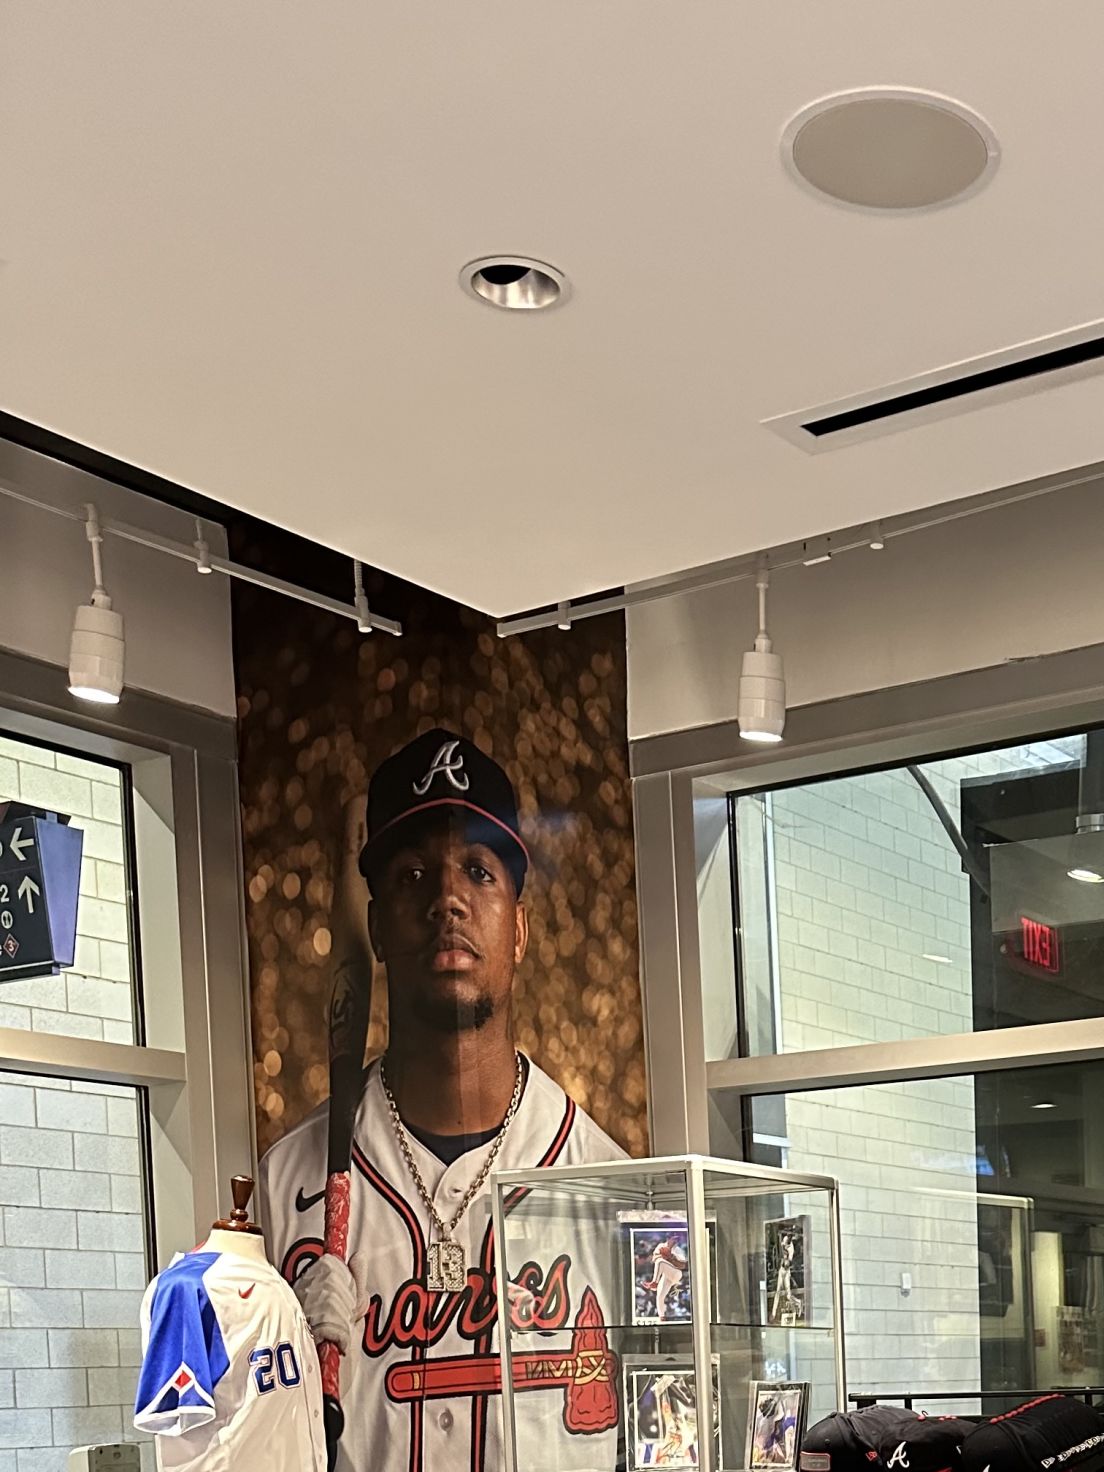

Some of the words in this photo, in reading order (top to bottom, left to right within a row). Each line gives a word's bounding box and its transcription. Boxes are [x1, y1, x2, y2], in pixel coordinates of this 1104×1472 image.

[412, 740, 470, 795] A
[427, 1242, 466, 1291] 13
[248, 1341, 301, 1396] 20
[886, 1441, 910, 1469] A
